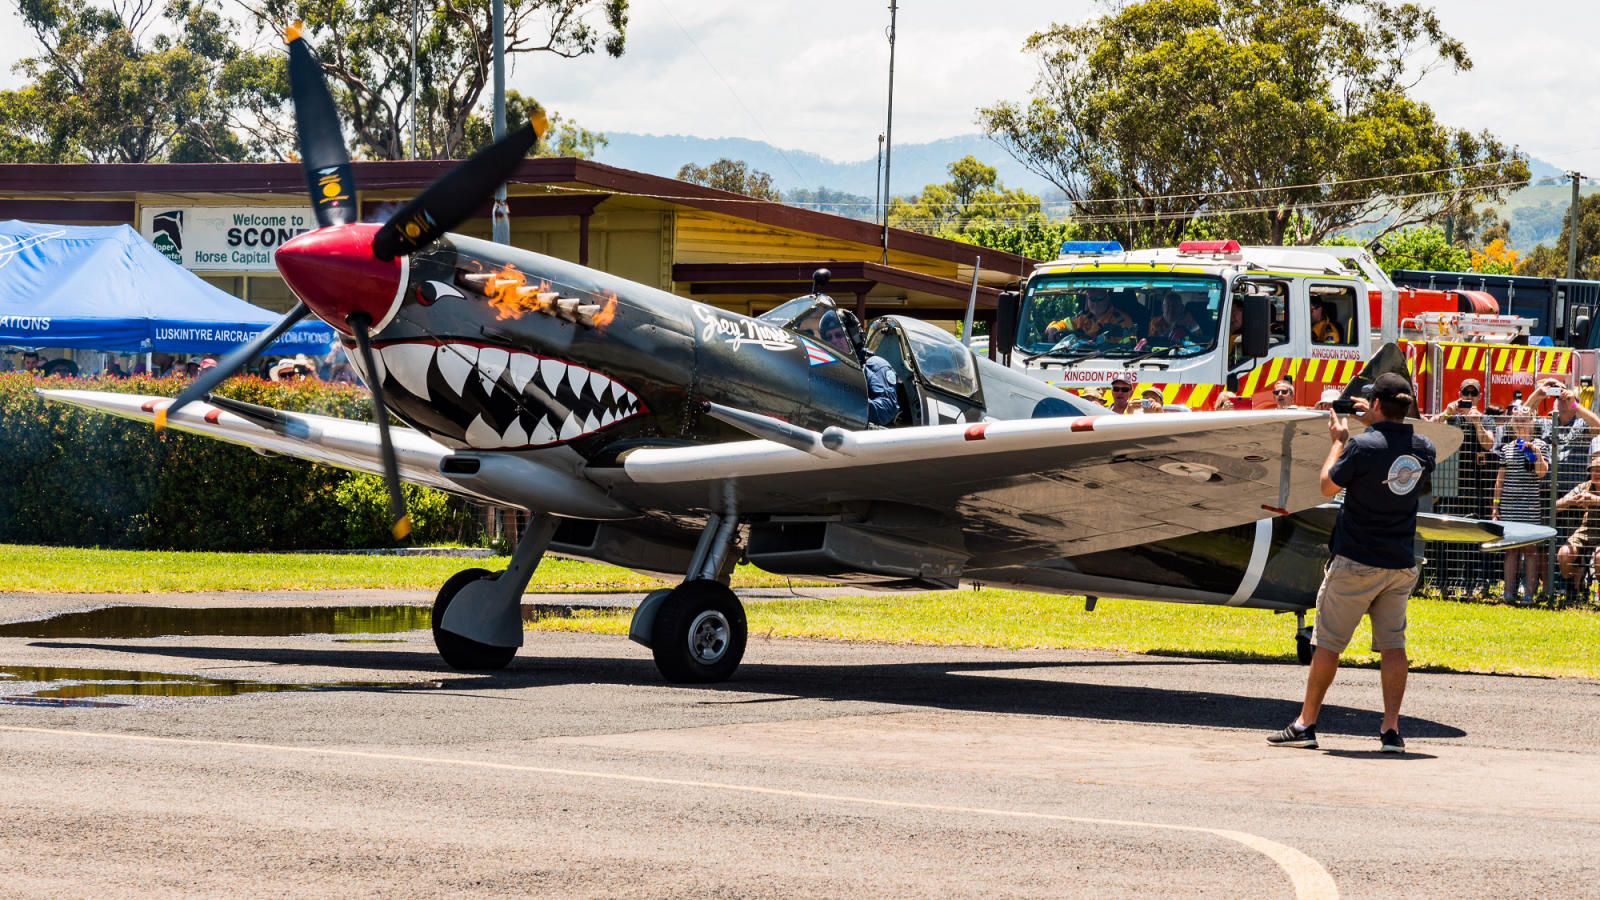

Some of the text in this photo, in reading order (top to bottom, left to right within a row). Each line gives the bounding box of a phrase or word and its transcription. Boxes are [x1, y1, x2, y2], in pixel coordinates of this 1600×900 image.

[233, 213, 304, 226] Welcome to
[195, 251, 270, 264] Horse Capital
[0, 315, 51, 330] ATIONS
[692, 304, 744, 351] Grey
[155, 328, 213, 341] LUSKINTYRE
[1312, 348, 1360, 360] KINGDON PONDS
[1064, 371, 1138, 382] KINGDON PODS
[1491, 374, 1533, 385] KINGDON PONDS
